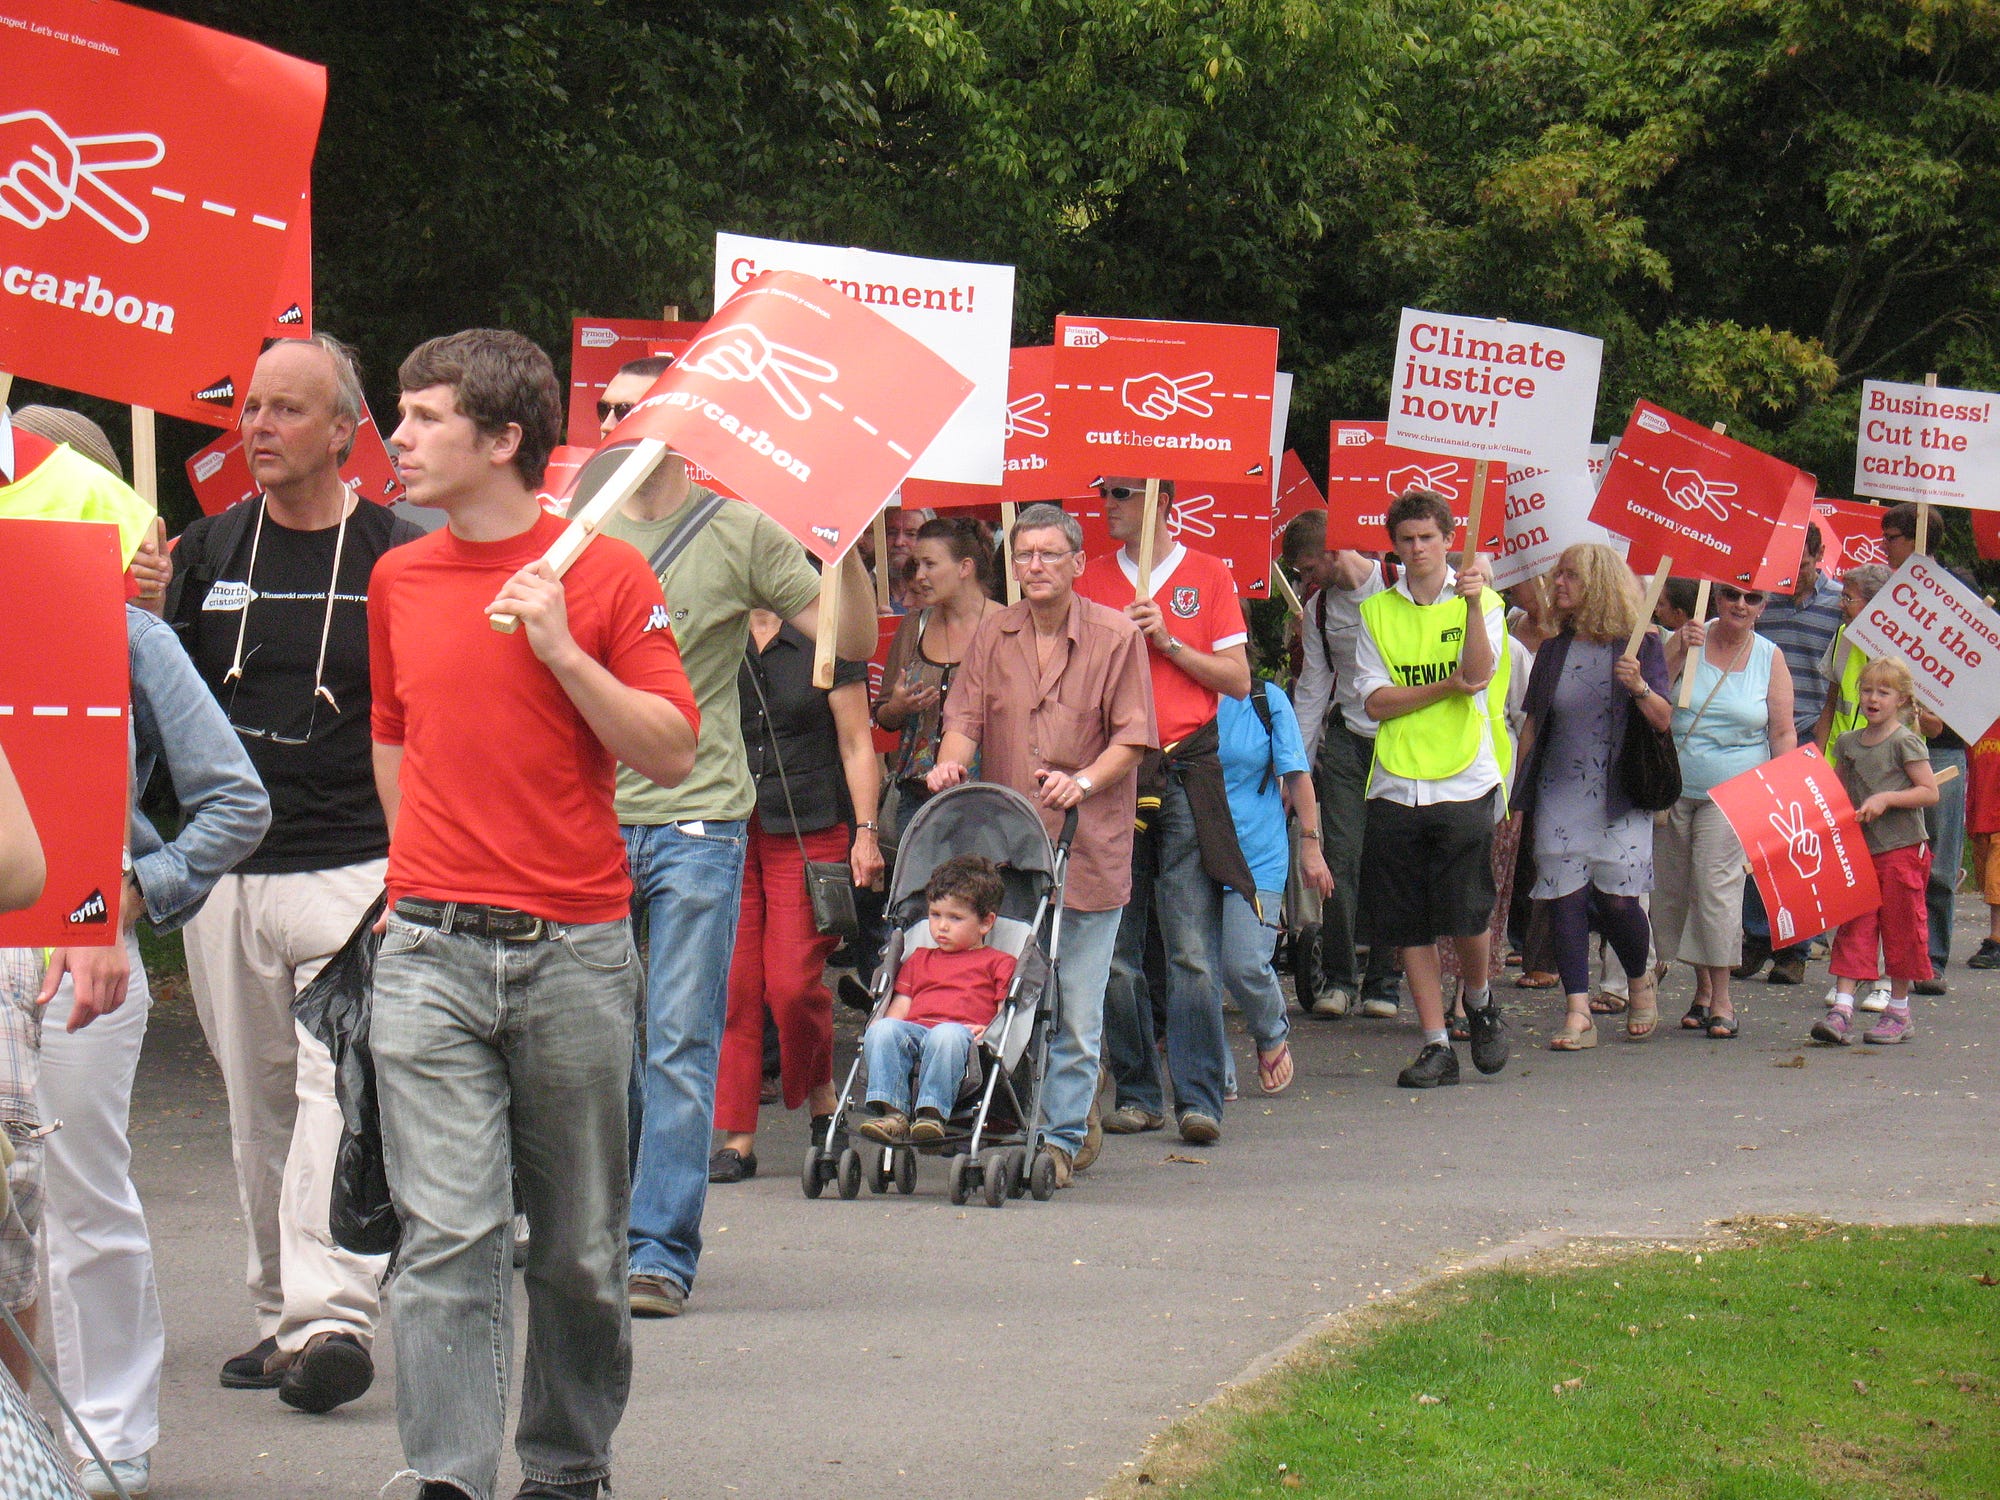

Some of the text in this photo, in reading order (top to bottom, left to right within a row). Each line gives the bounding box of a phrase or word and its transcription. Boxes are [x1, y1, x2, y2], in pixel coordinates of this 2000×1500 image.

[29, 22, 52, 37] Let's
[53, 31, 69, 42] cut
[71, 34, 86, 47] the
[87, 39, 120, 57] carbon.
[0, 265, 175, 335] carbon
[730, 257, 976, 313] Gnment!
[278, 306, 302, 324] cyfri
[1073, 331, 1100, 346] aid
[1409, 323, 1566, 371] Climate
[196, 382, 235, 400] count
[1402, 356, 1536, 399] justice
[1400, 395, 1499, 427] now!
[1868, 390, 1990, 424] Business!
[1085, 430, 1232, 451] cutthecarbon
[1345, 432, 1368, 445] aid
[1396, 430, 1532, 456] www.christianaid.org.uk/climate
[1866, 420, 1968, 452] Cut the
[1862, 455, 1956, 482] carbon
[1505, 492, 1546, 520] the
[811, 526, 839, 543] cyfri
[1626, 500, 1732, 555] torrwnycarbon
[212, 586, 248, 596] morth
[1892, 583, 1982, 668] Cut the
[1870, 609, 1955, 688] carbon
[1804, 776, 1857, 888] torrwnycarbon
[69, 895, 105, 923] cyfri
